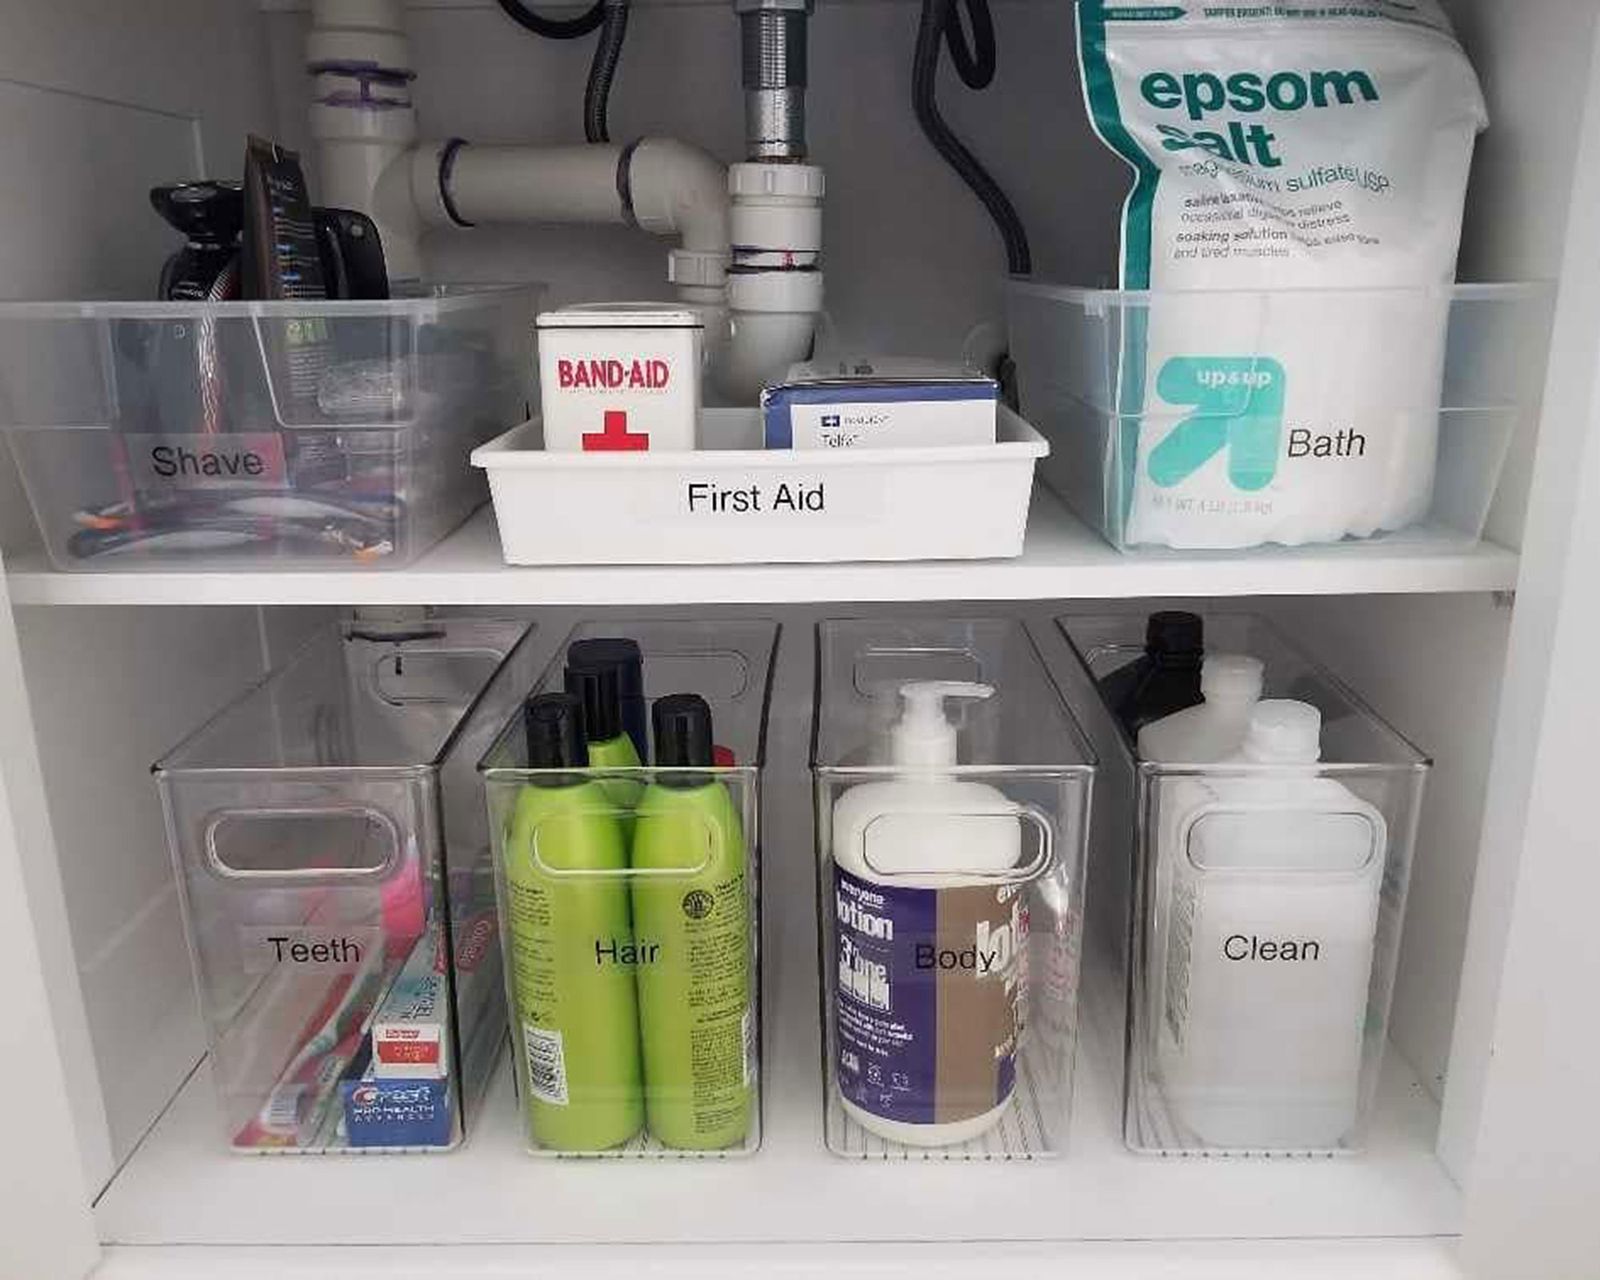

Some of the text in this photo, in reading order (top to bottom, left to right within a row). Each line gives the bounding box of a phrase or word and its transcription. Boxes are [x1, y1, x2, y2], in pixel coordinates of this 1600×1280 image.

[1140, 70, 1379, 121] epsom
[1156, 121, 1282, 168] salt
[1286, 165, 1356, 192] sulfate
[1176, 230, 1230, 244] soaking
[1234, 227, 1289, 243] solution
[558, 359, 669, 389] BAND-AID
[1287, 428, 1367, 458] Bath
[151, 446, 265, 477] Shave
[687, 483, 825, 512] First Aid
[836, 890, 893, 940] lotion
[267, 937, 361, 963] Teeth
[595, 939, 660, 965] Hair
[915, 943, 997, 972] Body
[1223, 934, 1321, 961] Clean
